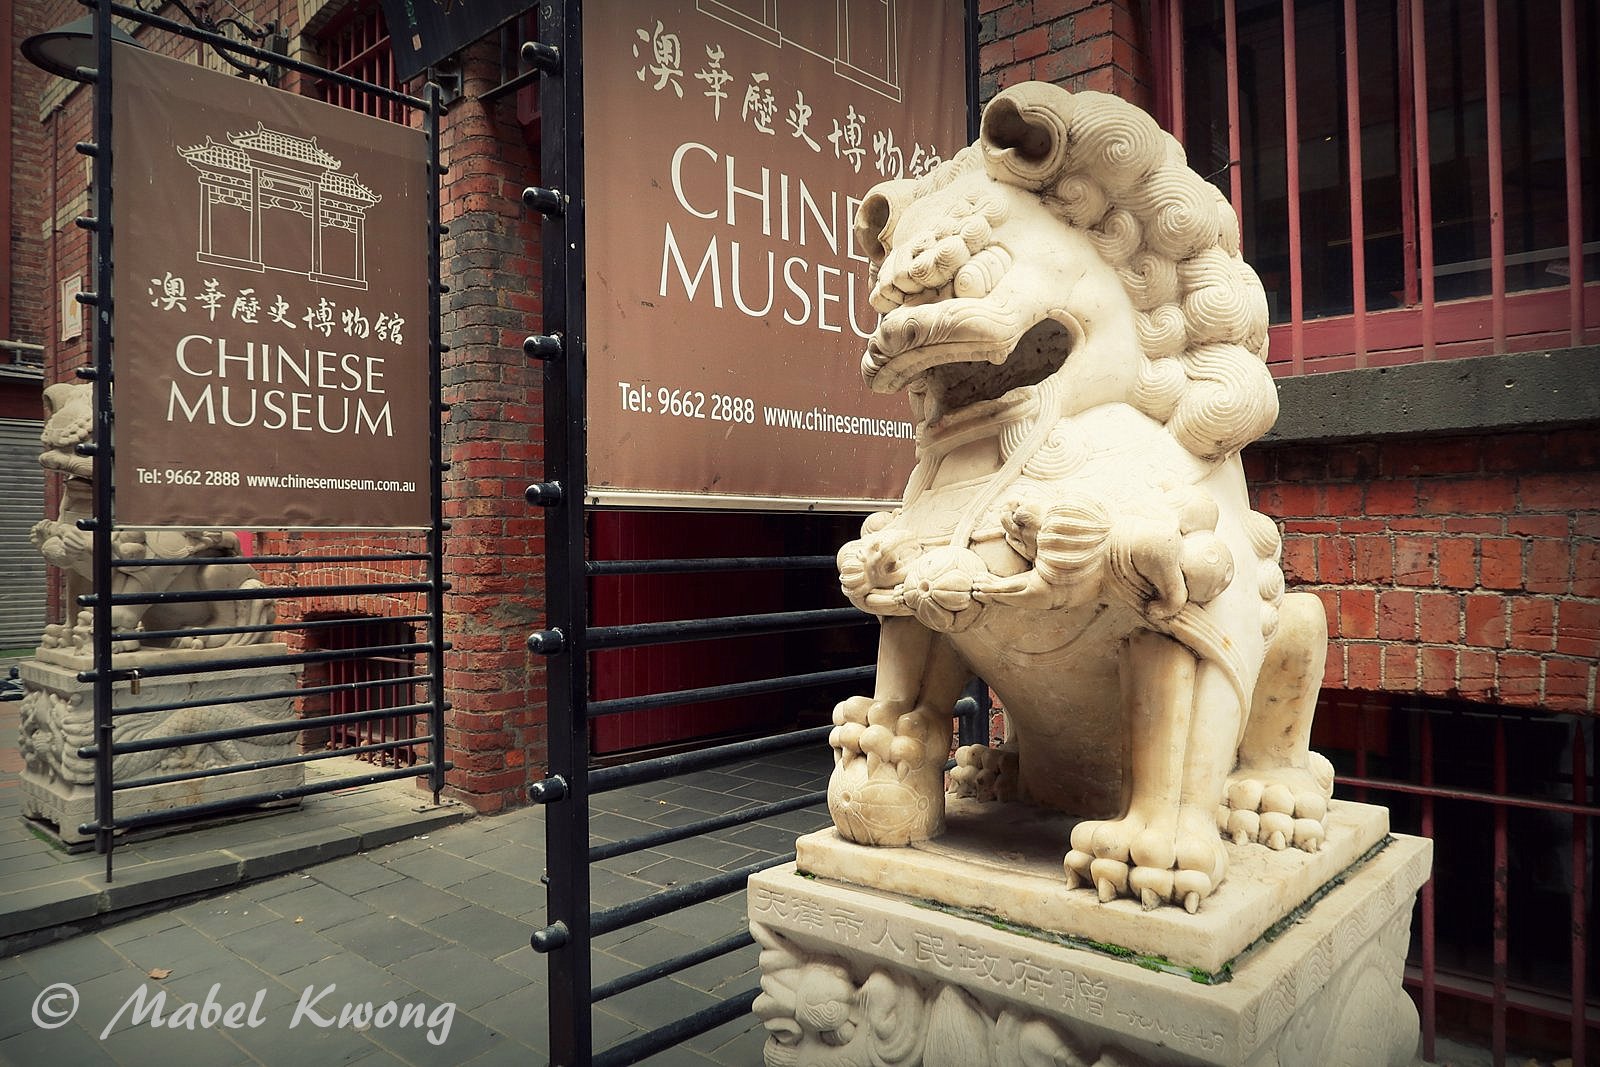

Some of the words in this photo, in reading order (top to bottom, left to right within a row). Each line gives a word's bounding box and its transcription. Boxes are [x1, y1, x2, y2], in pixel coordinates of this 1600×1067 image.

[148, 271, 405, 345] 澳華歷史博物館
[175, 334, 385, 394] CHINESE
[166, 380, 394, 437] MUSEUM
[618, 382, 652, 413] Tel:
[657, 387, 705, 418] 9662
[710, 394, 755, 424] 2888
[136, 468, 162, 484] Tel:
[165, 469, 201, 486] 9662
[205, 471, 240, 486] 2888
[247, 473, 416, 493] www.chinesemuseum.com.au
